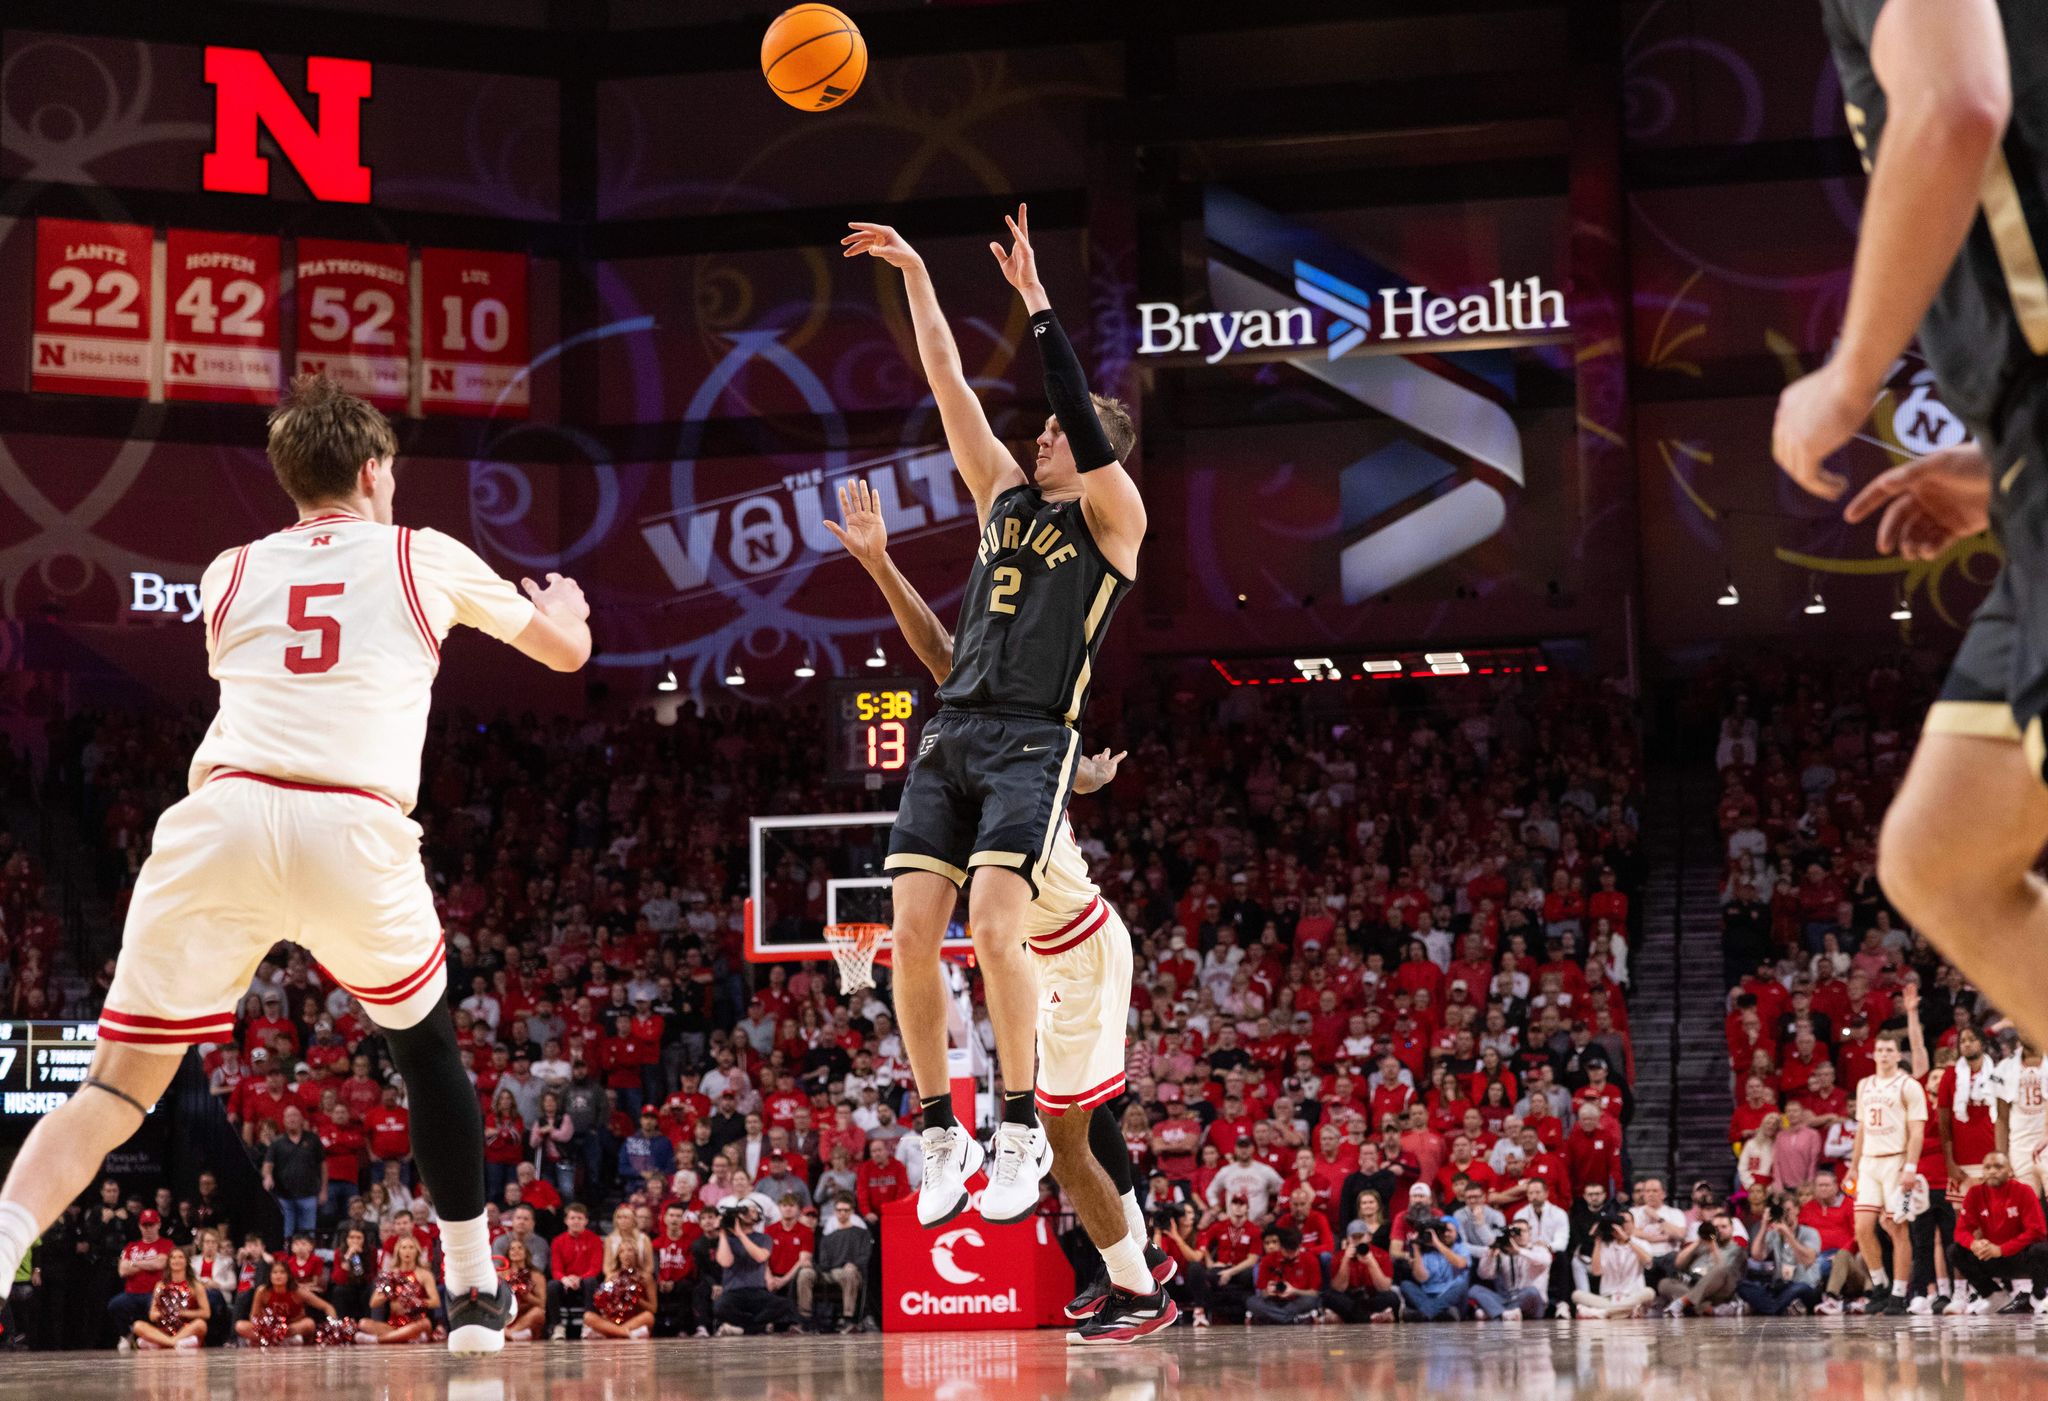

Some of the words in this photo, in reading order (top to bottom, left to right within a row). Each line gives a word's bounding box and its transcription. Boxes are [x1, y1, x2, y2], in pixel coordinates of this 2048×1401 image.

[203, 45, 373, 204] N
[65, 244, 127, 265] LANTZ
[48, 266, 140, 328] 22
[175, 277, 265, 337] 42
[309, 287, 396, 346] 52
[442, 295, 510, 352] 10
[1137, 302, 1317, 364] Bryan
[1378, 275, 1570, 340] Health
[39, 344, 65, 368] N
[171, 352, 196, 376] N
[430, 369, 454, 391] N
[1906, 410, 1948, 445] N
[783, 468, 824, 491] THE
[310, 535, 331, 547] N
[745, 533, 777, 563] N
[130, 572, 203, 623] Bry
[989, 566, 1022, 615] 2
[284, 582, 345, 675] 5
[856, 691, 912, 720] 5:38
[867, 721, 905, 769] 13
[77, 1024, 98, 1040] PU
[49, 1049, 96, 1064] TIMEOUT
[4, 1092, 68, 1114] HUSKER
[1870, 1108, 1882, 1126] 31
[900, 1288, 1017, 1315] Channel
